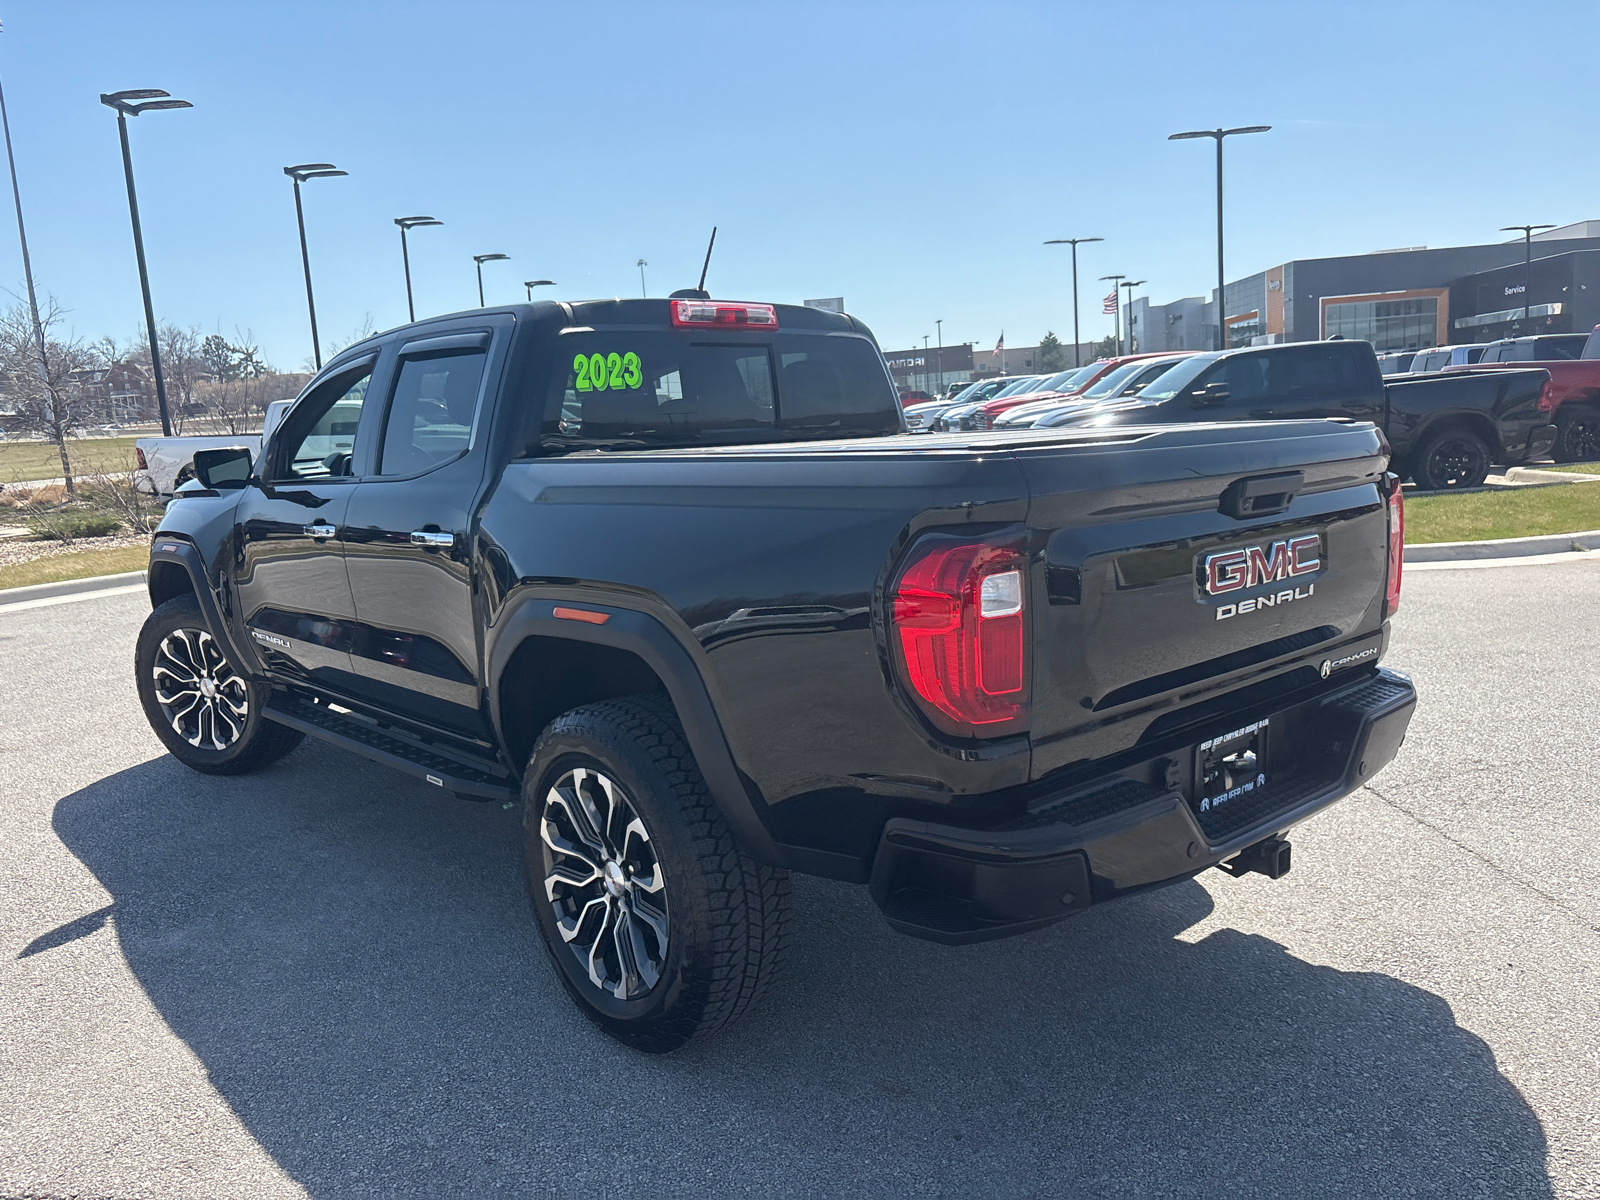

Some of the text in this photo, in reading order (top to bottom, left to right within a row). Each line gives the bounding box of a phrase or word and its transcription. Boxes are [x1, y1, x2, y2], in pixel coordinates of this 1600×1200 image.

[1504, 285, 1526, 296] Service
[573, 351, 643, 392] 2023
[886, 357, 925, 369] YUNDAI
[1205, 534, 1320, 596] GMC
[1216, 583, 1315, 620] DENALI
[251, 630, 291, 649] DENALI
[1331, 647, 1378, 667] CANYON
[1200, 718, 1269, 751] REED JEEP CHRYSLER DODGE RAM
